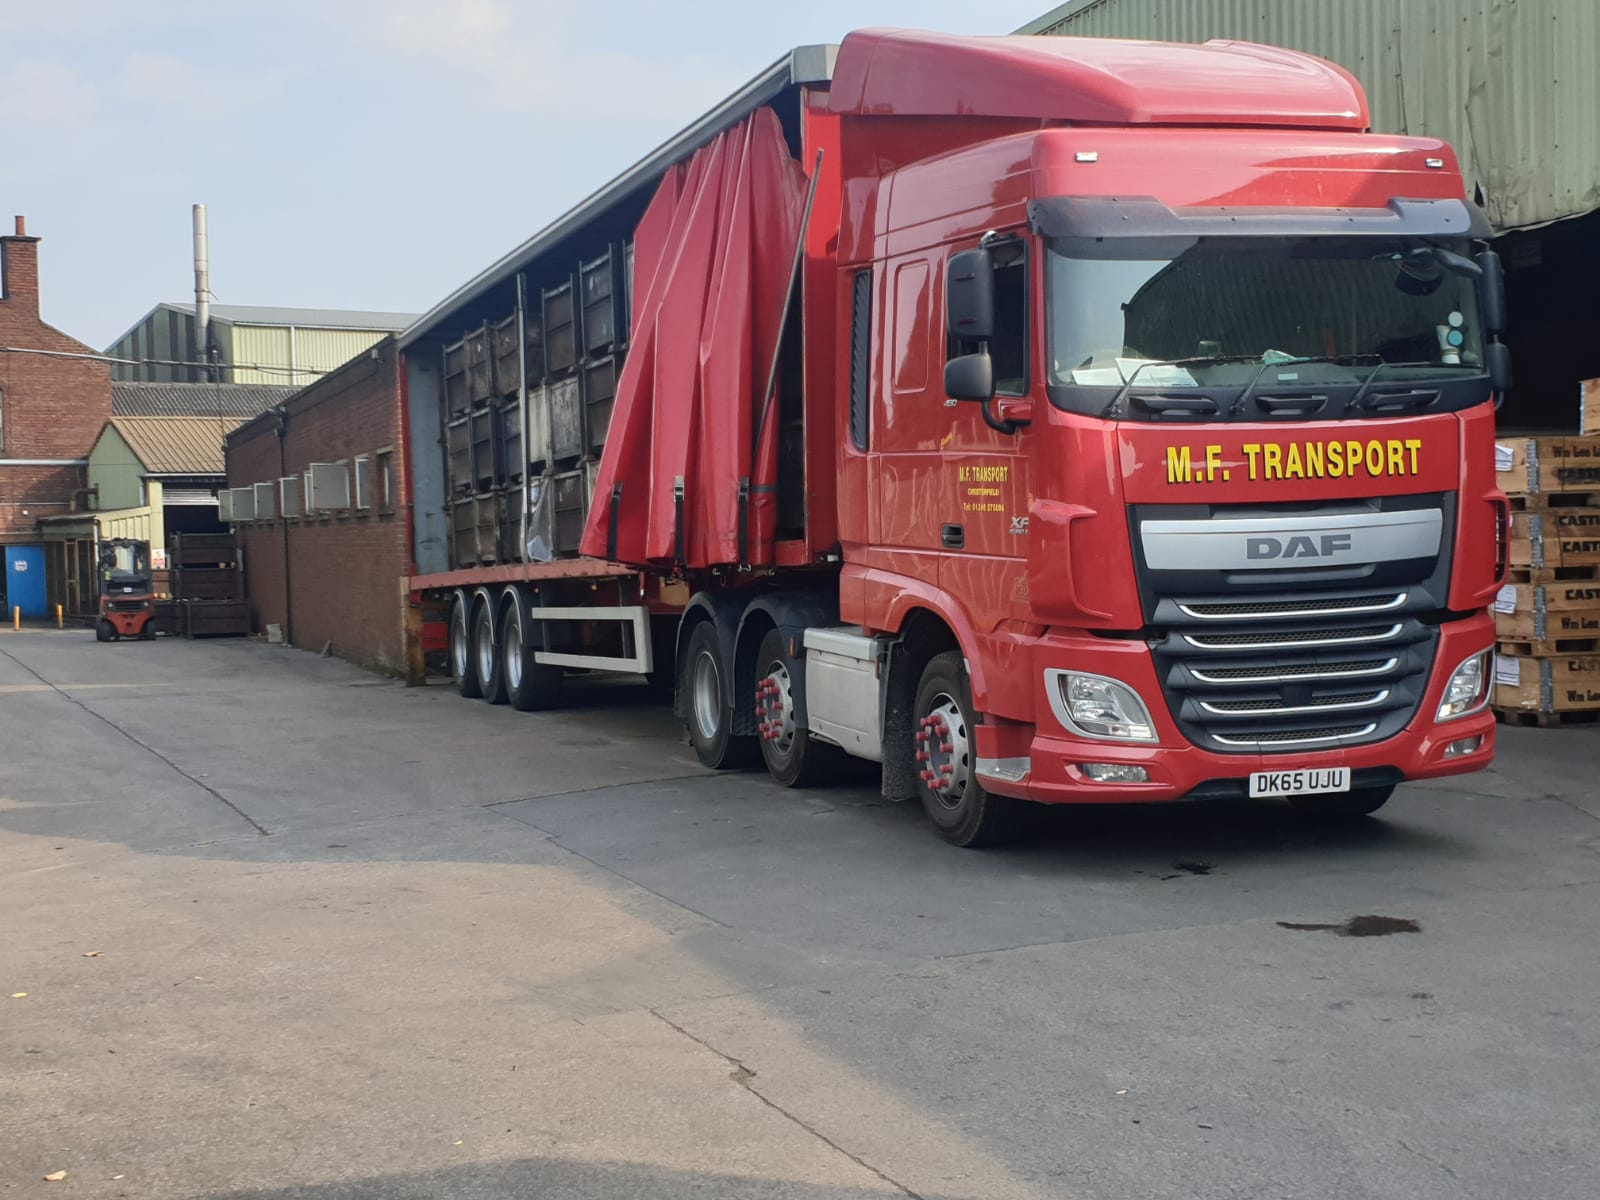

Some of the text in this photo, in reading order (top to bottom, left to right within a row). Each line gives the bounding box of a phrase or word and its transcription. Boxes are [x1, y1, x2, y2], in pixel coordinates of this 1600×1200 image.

[1166, 439, 1421, 482] M.F. TRANSPORT
[972, 466, 1008, 482] TRANSPORT
[1010, 516, 1029, 529] XF
[1247, 534, 1351, 560] DAF
[1257, 770, 1343, 793] DK65 UJU
